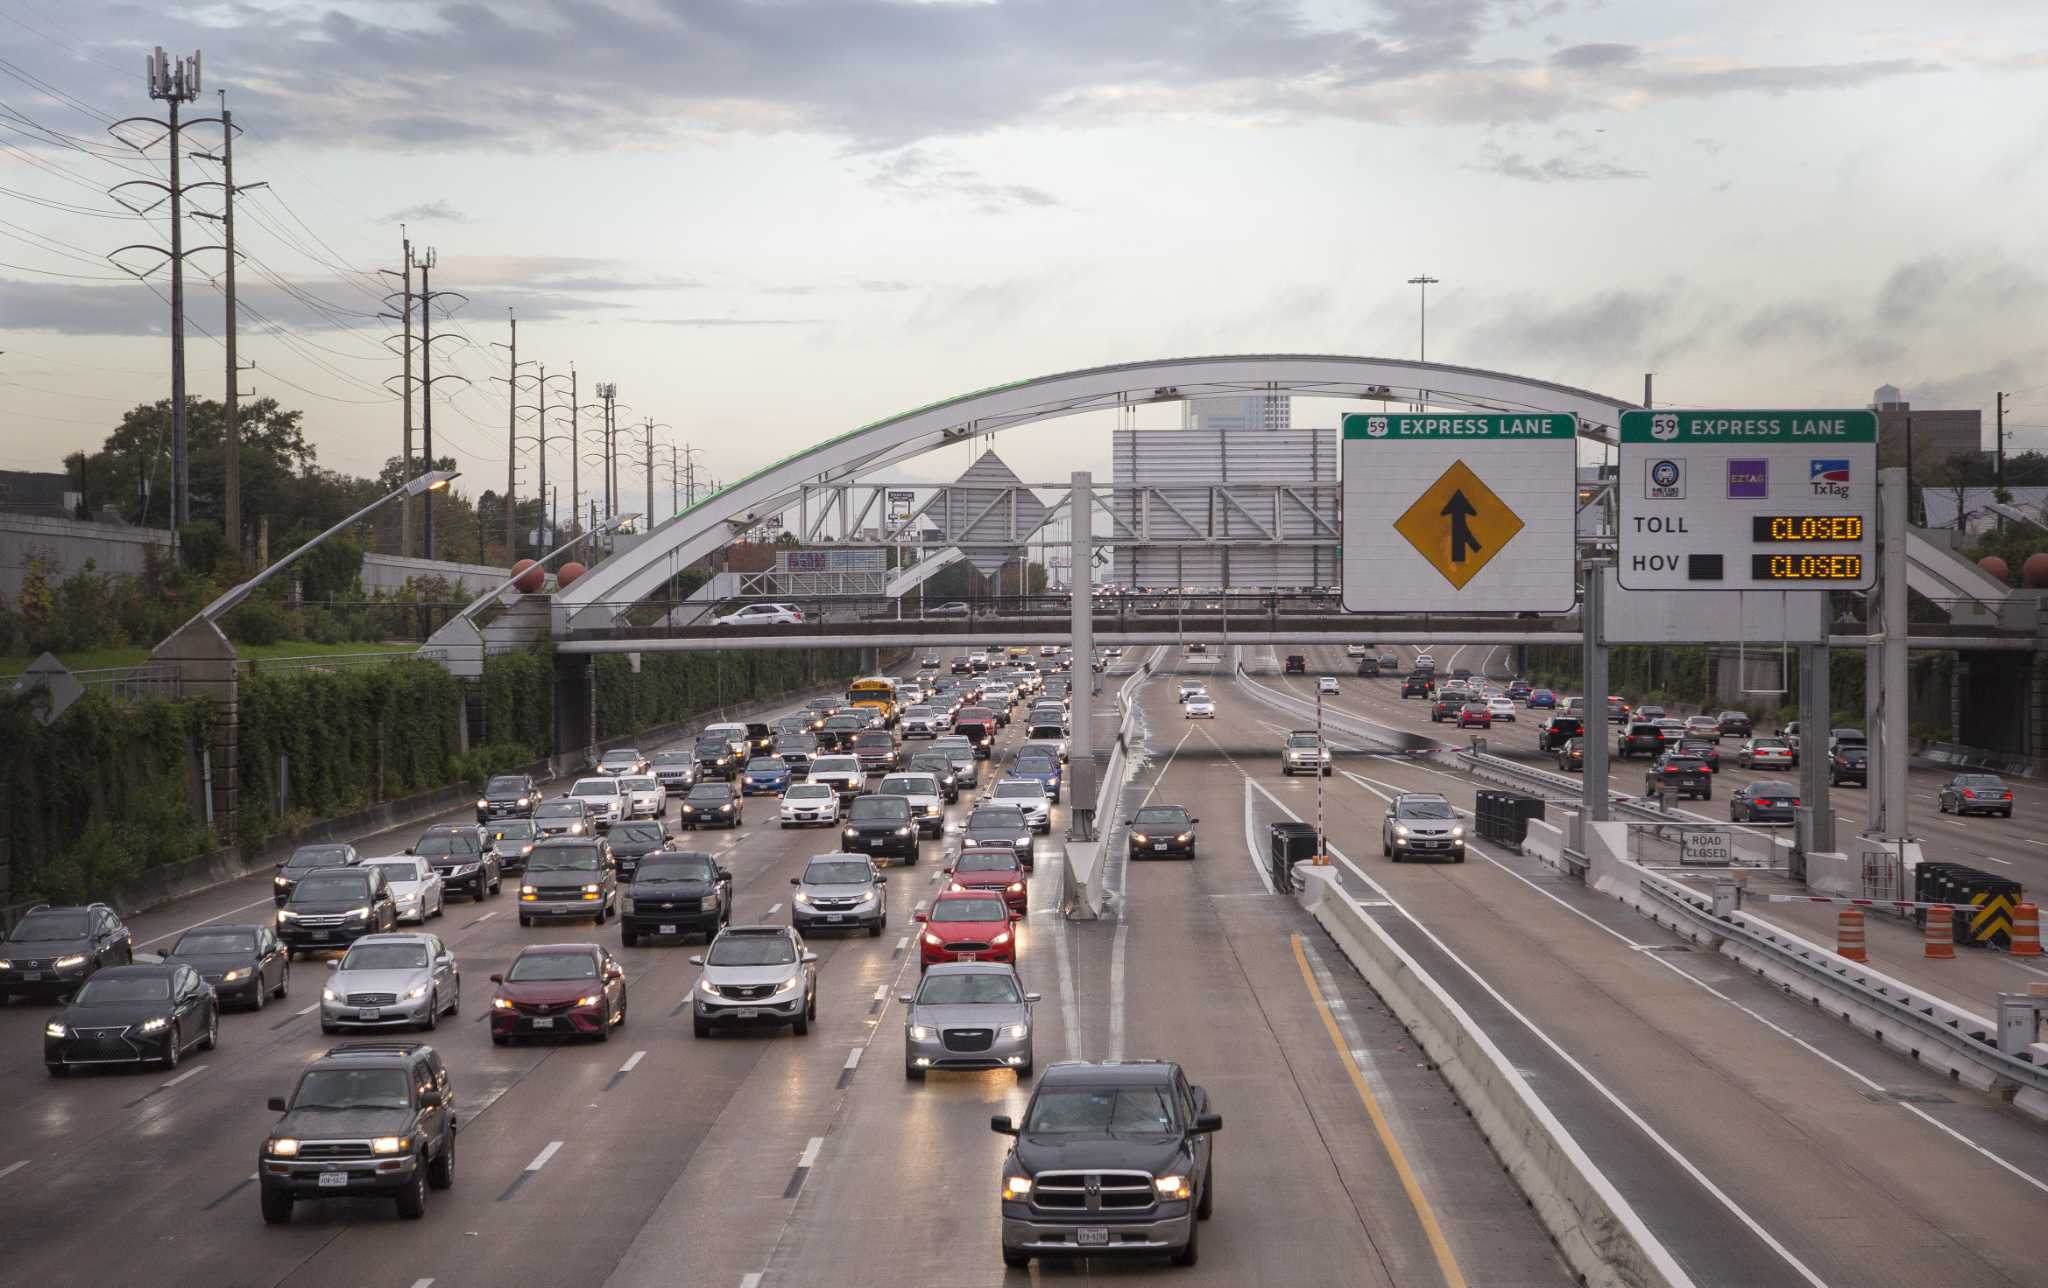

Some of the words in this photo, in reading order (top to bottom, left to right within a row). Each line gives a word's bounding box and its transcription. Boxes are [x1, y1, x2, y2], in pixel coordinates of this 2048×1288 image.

[1369, 421, 1386, 432] 59
[1400, 419, 1489, 434] EXPRESS
[1500, 419, 1552, 434] LANE
[1654, 419, 1676, 434] 59
[1691, 419, 1780, 435] EXPRESS
[1792, 419, 1845, 435] LANE
[1810, 482, 1849, 499] TxTag
[1633, 517, 1688, 533] TOLL
[1772, 518, 1862, 539] CLOSED
[1633, 555, 1680, 571] HOV
[1771, 556, 1860, 577] CLOSED
[1692, 836, 1722, 845] ROAD
[1686, 848, 1727, 858] CLOSED
